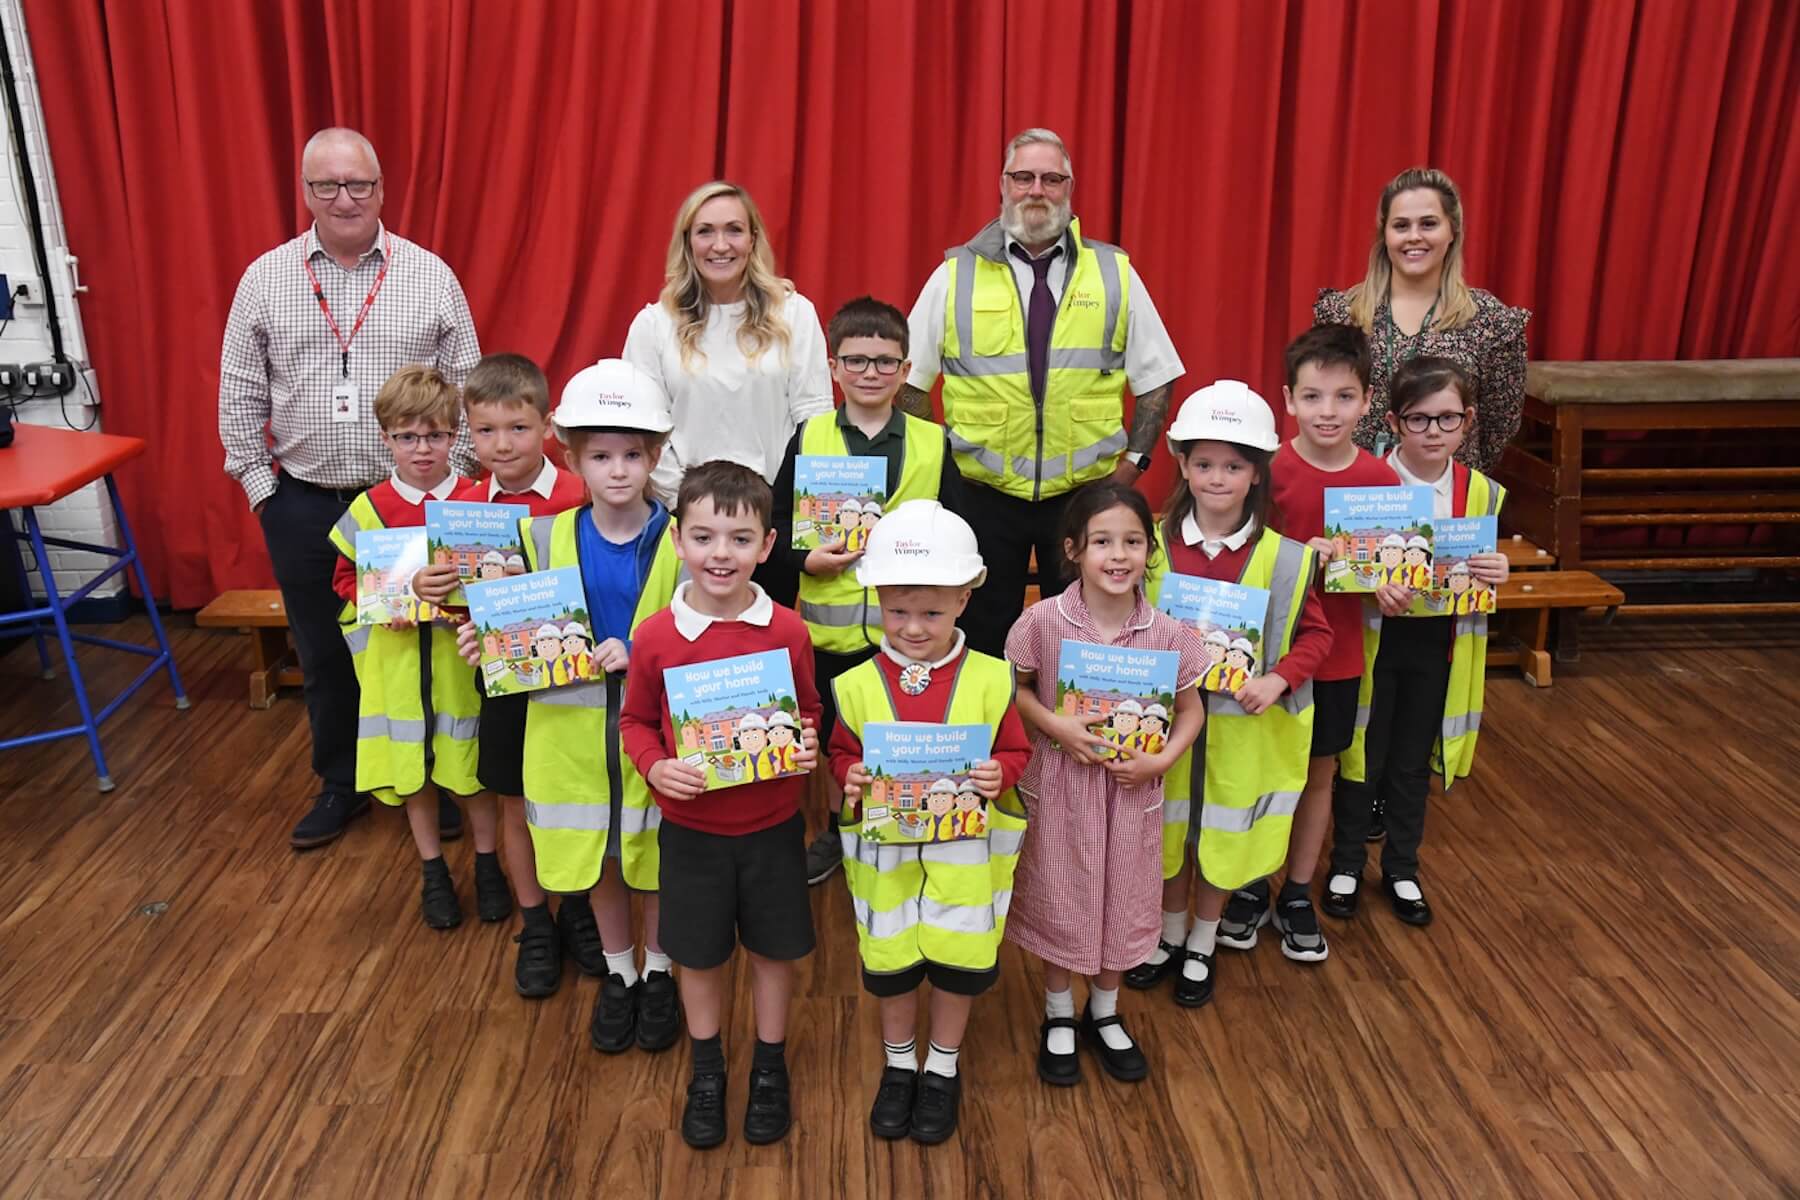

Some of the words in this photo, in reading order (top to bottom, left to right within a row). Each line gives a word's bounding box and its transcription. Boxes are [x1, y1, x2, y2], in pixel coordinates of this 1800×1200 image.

[1071, 300, 1100, 309] impey
[598, 400, 631, 408] Wimpey
[1344, 493, 1366, 501] How
[1368, 493, 1384, 501] we
[1386, 491, 1413, 501] build
[443, 507, 464, 517] How
[466, 509, 481, 518] we
[484, 509, 511, 519] build
[1349, 503, 1374, 515] your
[1377, 502, 1408, 512] home
[448, 520, 473, 530] your
[475, 519, 505, 529] home
[1457, 521, 1480, 531] build
[1448, 532, 1475, 542] home
[895, 548, 930, 557] Wimpey
[485, 586, 508, 597] How
[511, 582, 528, 592] we
[529, 575, 558, 590] build
[495, 595, 520, 611] your
[522, 590, 555, 602] home
[1080, 649, 1104, 660] How
[1108, 654, 1124, 663] we
[1127, 654, 1156, 666] build
[685, 671, 710, 682] How
[713, 668, 731, 678] we
[732, 659, 764, 674] build
[1086, 663, 1112, 673] your
[1116, 664, 1149, 677] home
[694, 681, 721, 697] your
[724, 675, 760, 689] home
[885, 731, 911, 742] How
[915, 734, 932, 742] we
[936, 730, 967, 742] build
[892, 745, 921, 756] your
[925, 744, 960, 754] home
